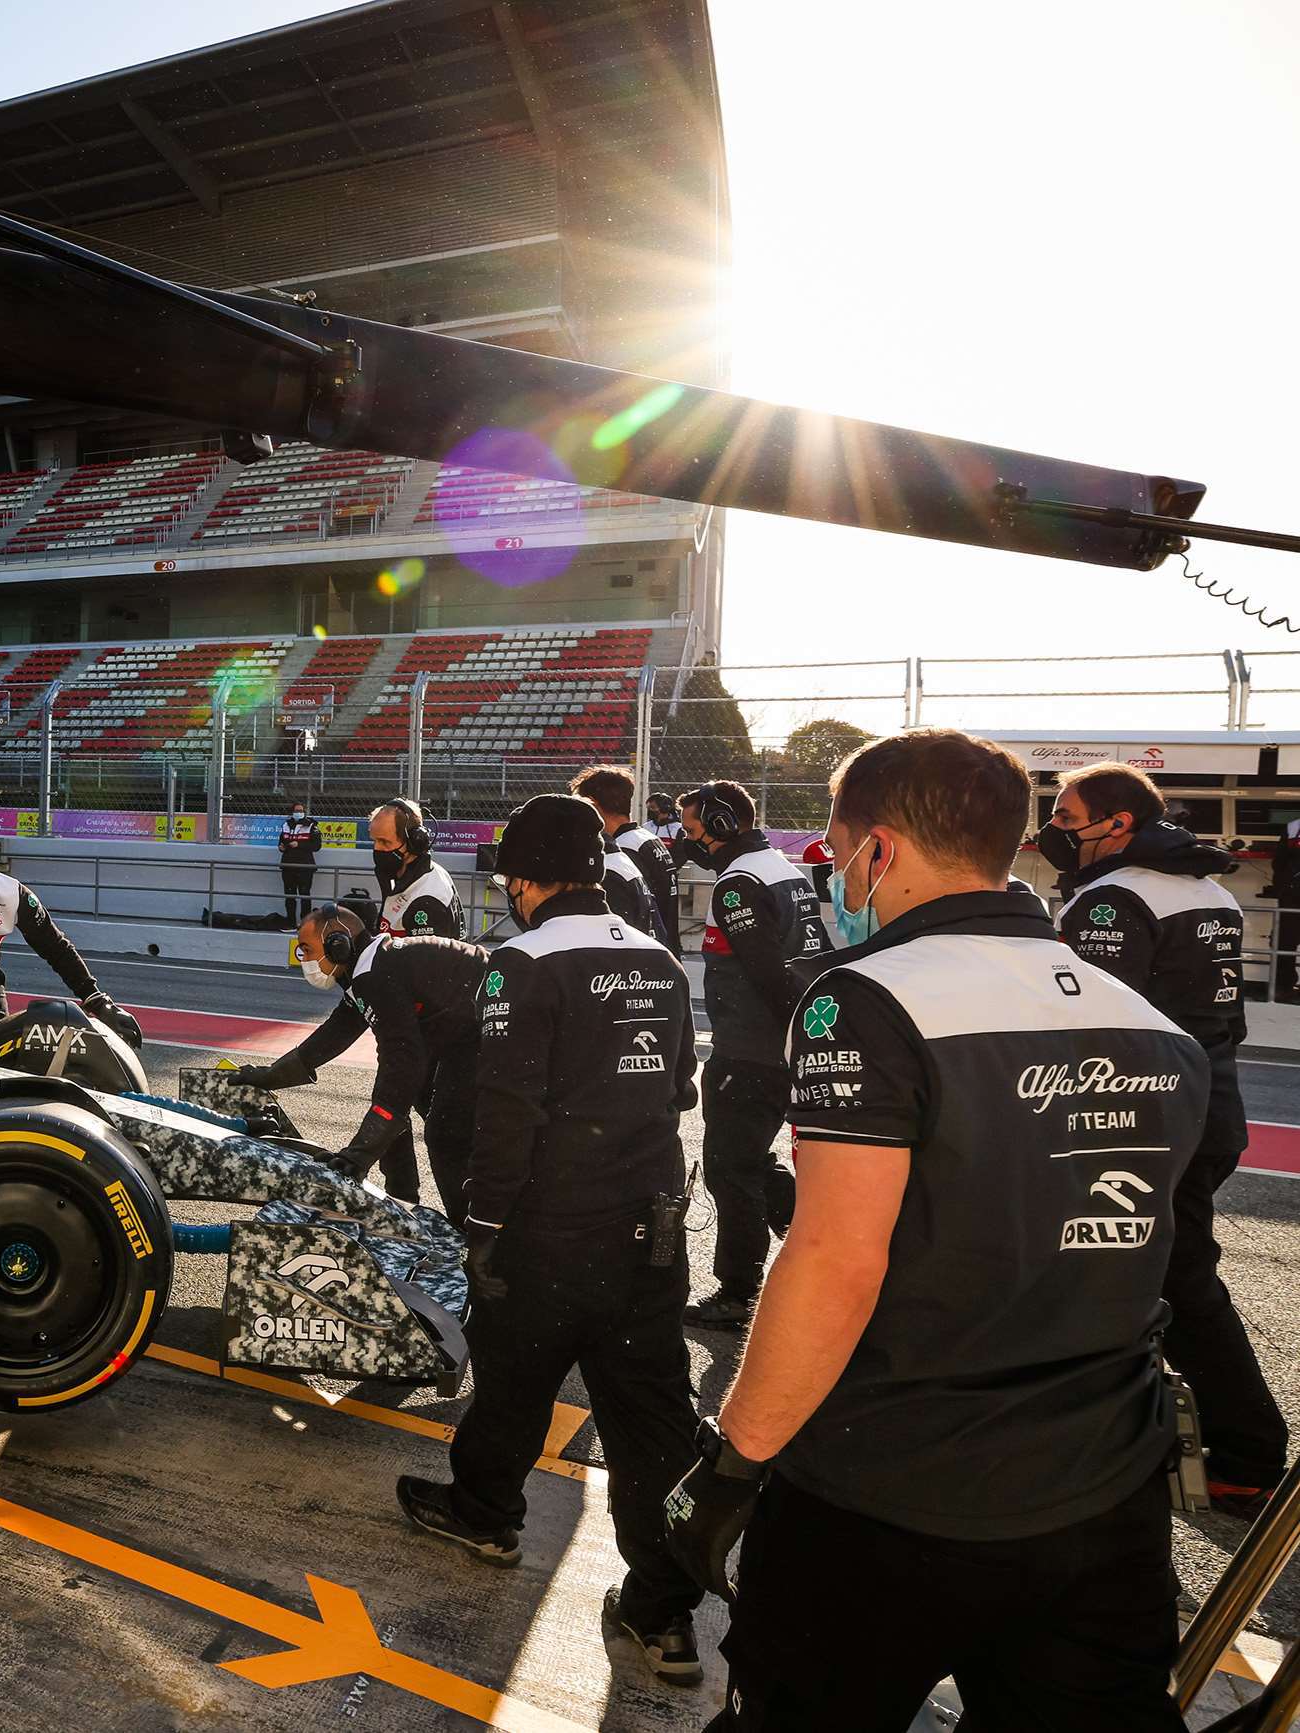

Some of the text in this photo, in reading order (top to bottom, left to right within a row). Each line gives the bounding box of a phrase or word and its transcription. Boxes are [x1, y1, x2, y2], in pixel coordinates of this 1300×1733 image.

[505, 538, 520, 549] 21
[161, 561, 175, 571] 20
[1031, 746, 1111, 761] Alfa Romeo
[730, 907, 752, 918] ADLER
[1089, 930, 1125, 940] ADLER
[1077, 943, 1104, 952] WEB
[590, 970, 674, 1002] Alfa Romeo
[619, 1057, 661, 1071] ORLEN
[805, 1050, 862, 1068] ADLER
[798, 1083, 830, 1102] WEB
[1016, 1057, 1181, 1114] Alfa Romeo
[1080, 1111, 1136, 1130] TEAM
[104, 1180, 154, 1260] PIRELLI
[1064, 1221, 1150, 1245] ORLEN
[253, 1315, 346, 1343] ORLEN
